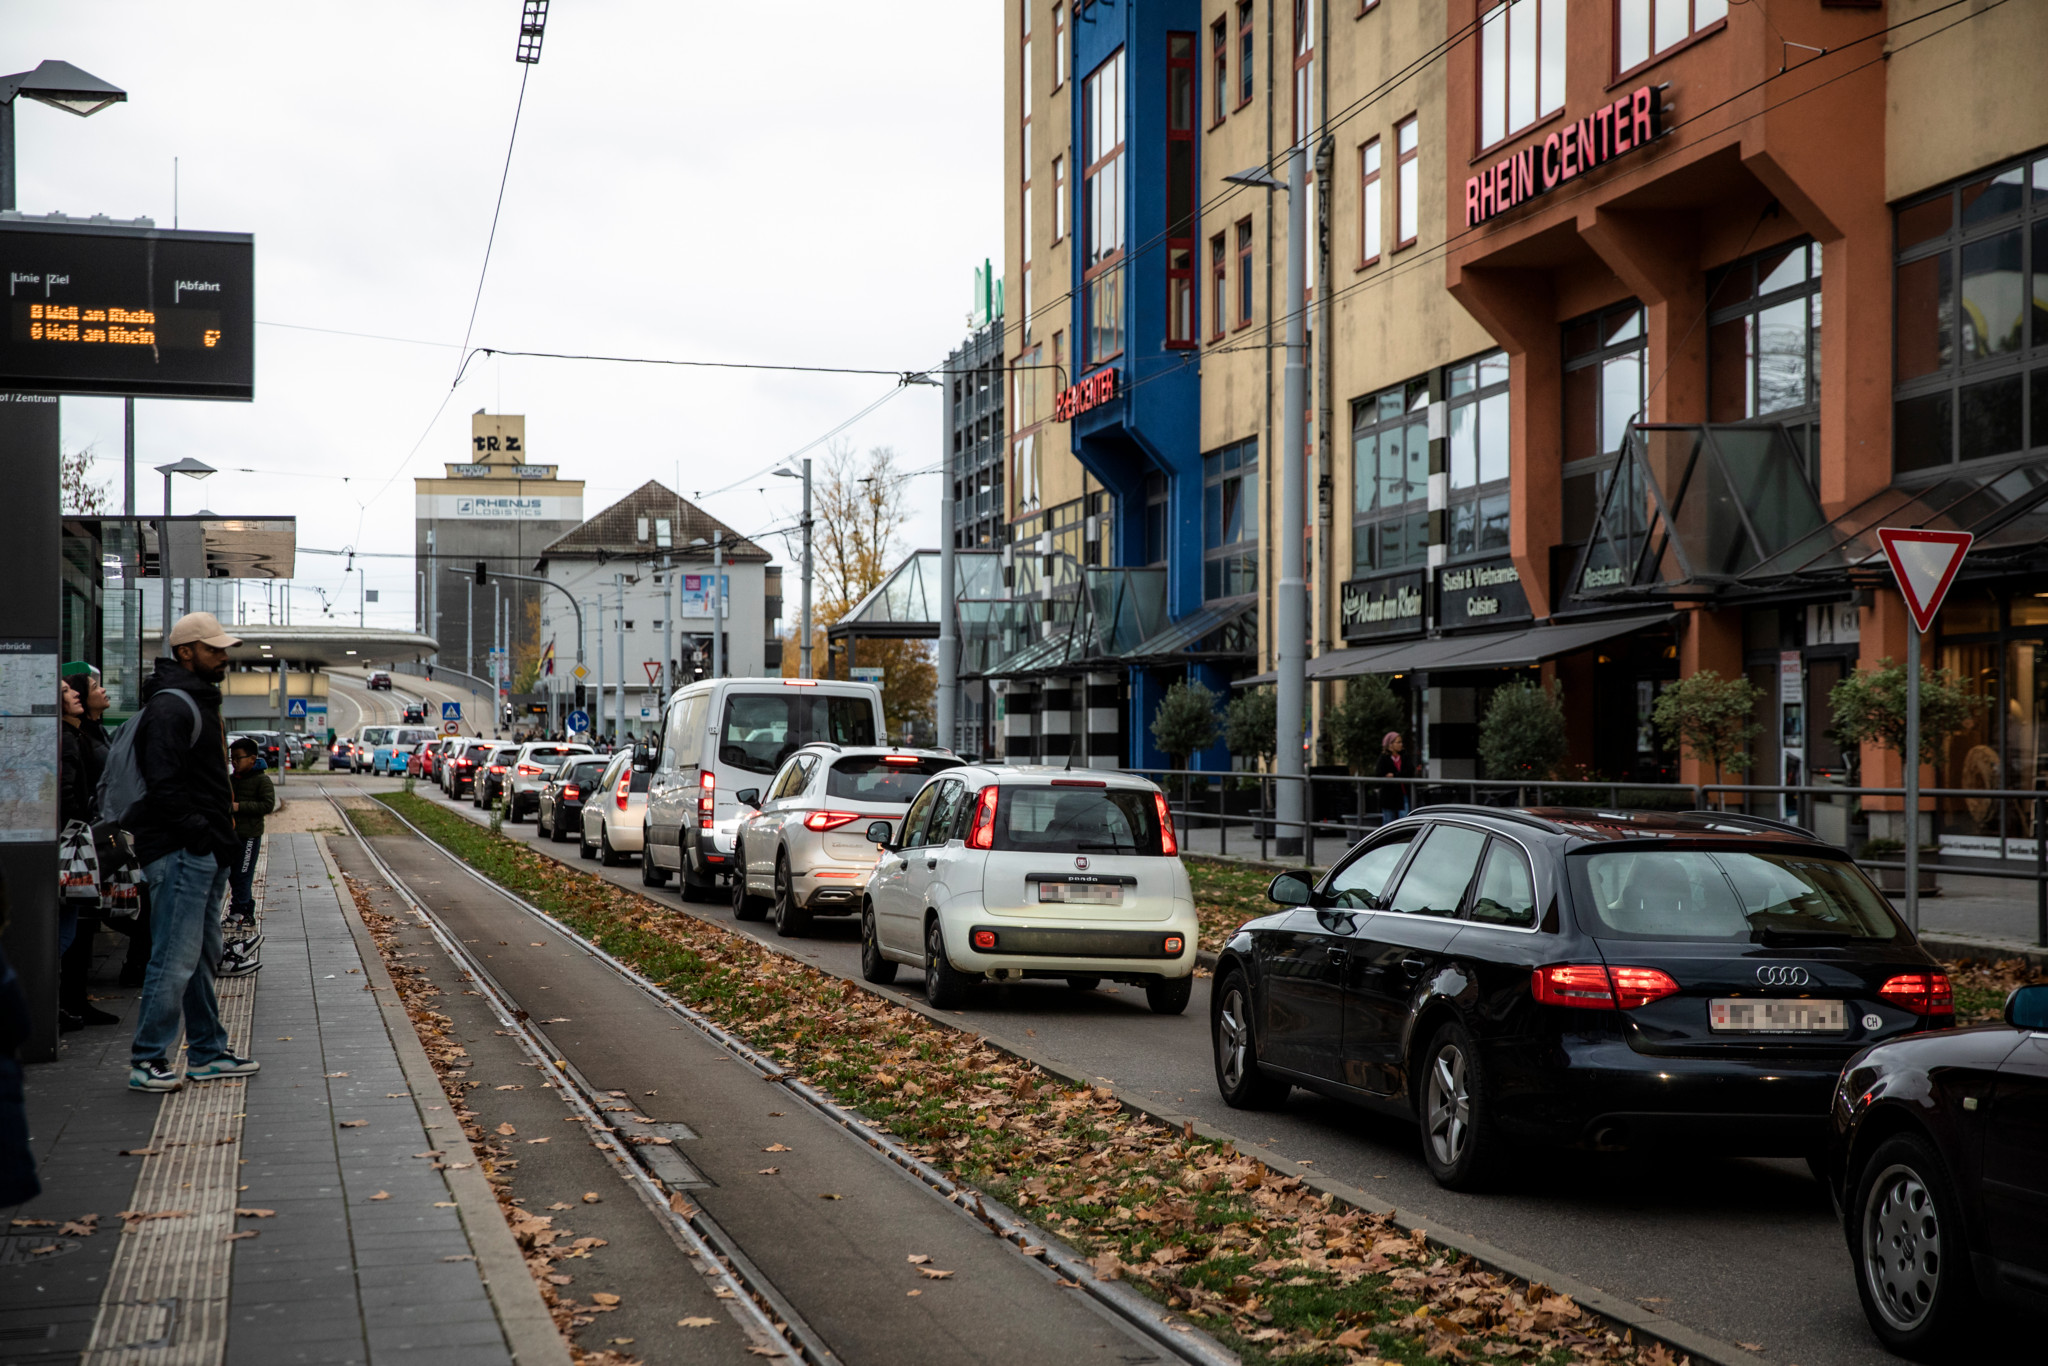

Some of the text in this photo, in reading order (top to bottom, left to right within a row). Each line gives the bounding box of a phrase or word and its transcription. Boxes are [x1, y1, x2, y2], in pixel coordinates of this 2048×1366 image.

[1466, 86, 1652, 227] RHEIN CENTER
[14, 273, 40, 283] Linie
[50, 274, 69, 284] Ziel
[180, 281, 220, 291] Abfahrt
[46, 305, 79, 320] Weil
[82, 310, 105, 321] am
[108, 308, 155, 323] Rhein
[46, 324, 79, 341] Weil
[82, 329, 105, 342] am
[108, 326, 155, 344] Rhein
[16, 394, 57, 403] Zentrum
[1080, 367, 1113, 413] CENTER
[476, 499, 541, 507] RHENUS
[1443, 566, 1519, 592] Sushi & Vietnames
[1398, 585, 1421, 618] Rhein
[1467, 596, 1498, 617] Cuisine
[1866, 1016, 1878, 1028] CH
